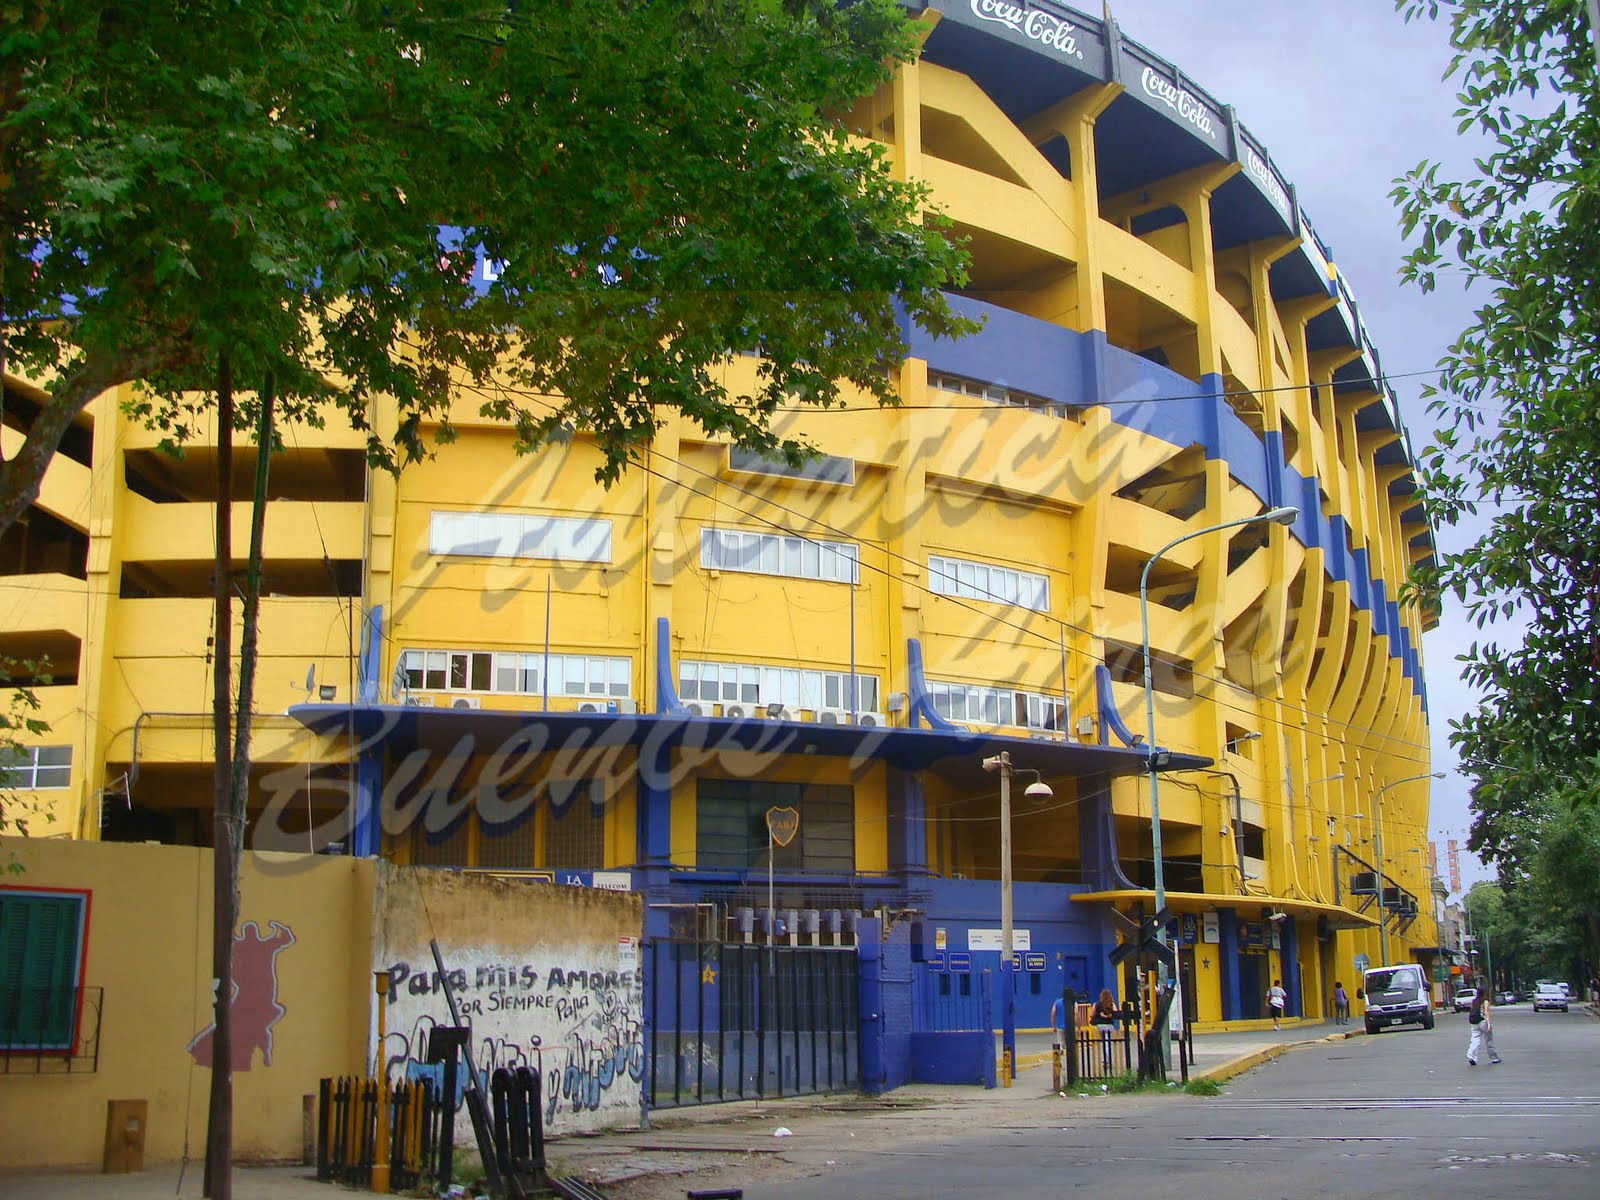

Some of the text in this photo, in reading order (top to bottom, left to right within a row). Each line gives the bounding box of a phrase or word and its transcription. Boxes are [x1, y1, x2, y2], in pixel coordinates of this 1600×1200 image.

[1141, 66, 1212, 135] Coca-Cola
[566, 875, 583, 885] LA
[387, 962, 469, 1004] Para
